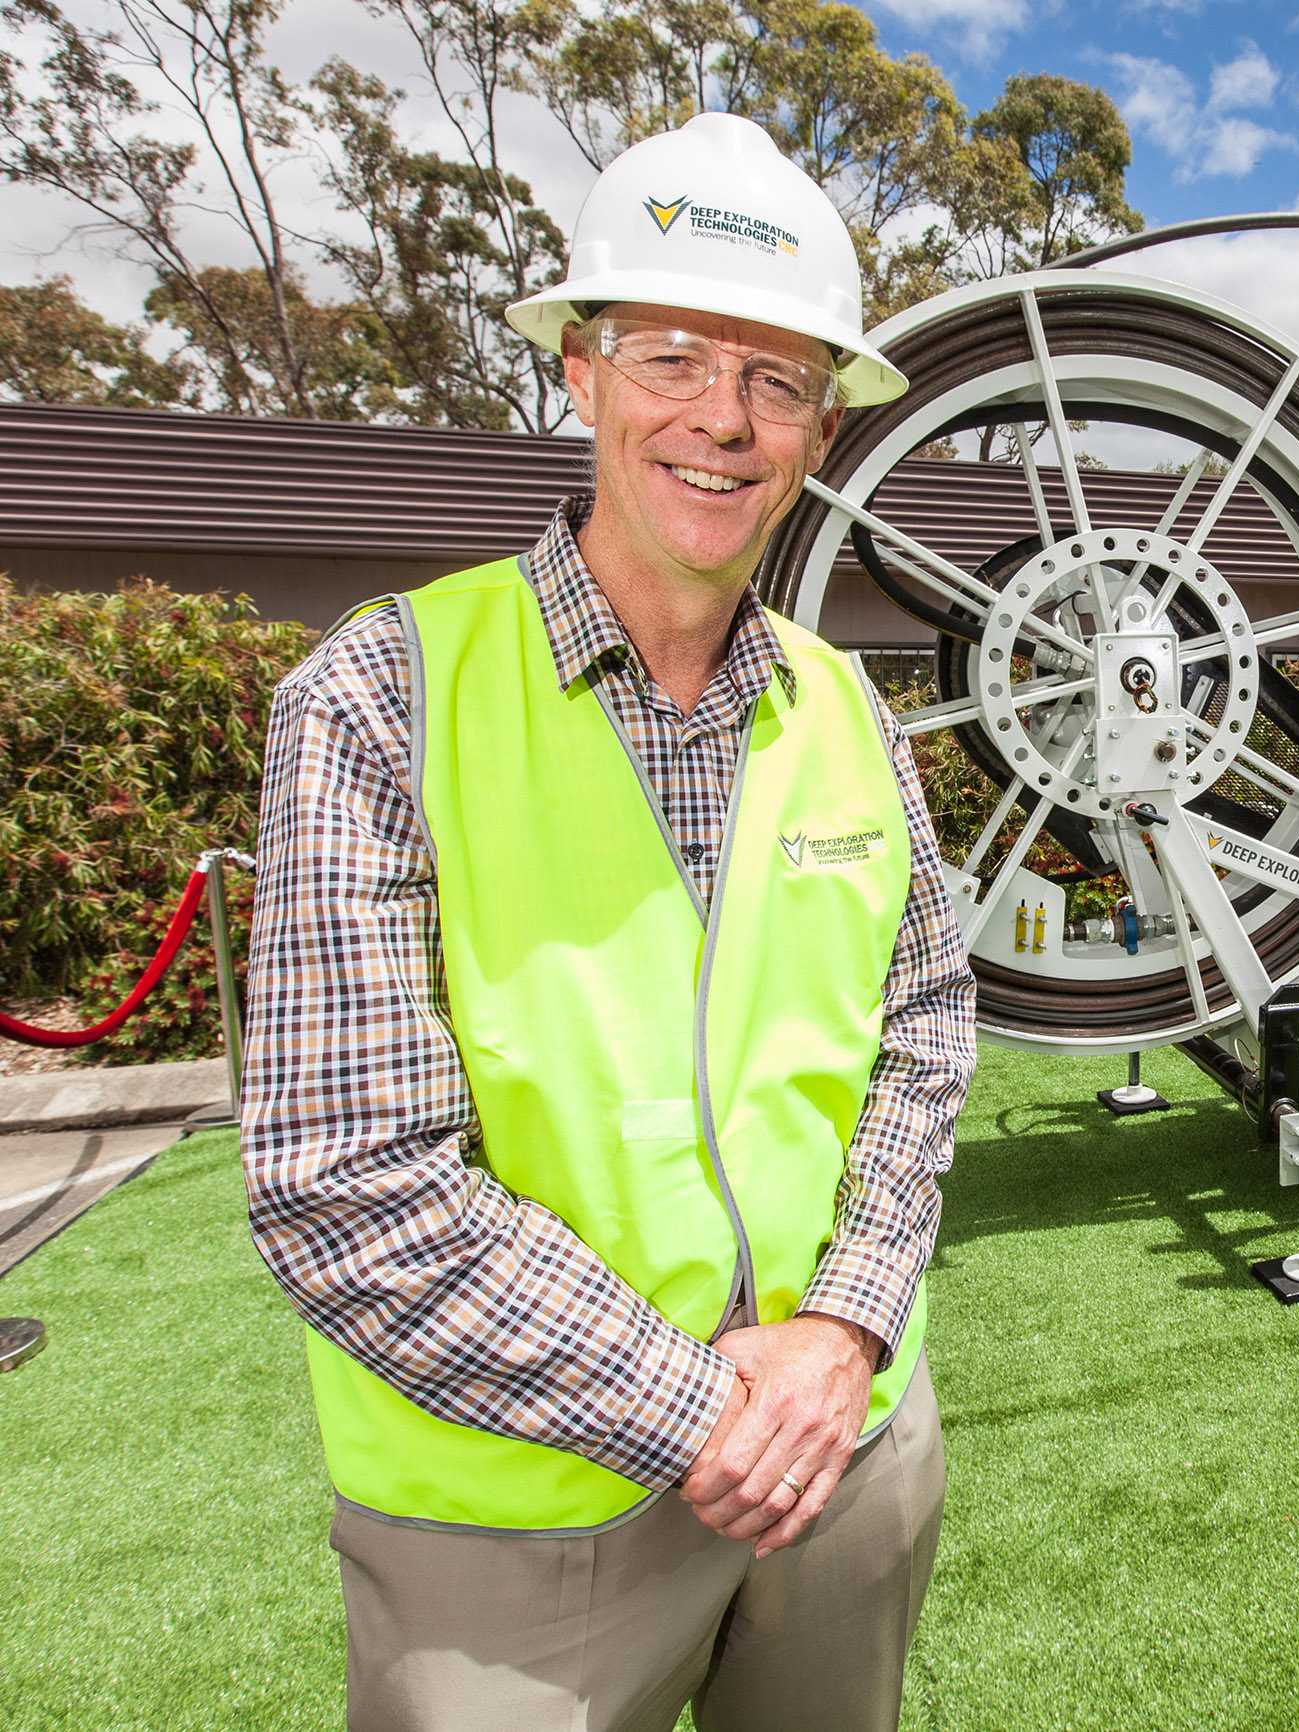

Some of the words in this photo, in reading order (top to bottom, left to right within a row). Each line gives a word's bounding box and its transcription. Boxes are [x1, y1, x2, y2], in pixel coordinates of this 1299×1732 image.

[690, 206, 722, 219] DEEP
[724, 211, 799, 247] EXPLORATION
[690, 217, 777, 247] TECHNOLOGIES
[691, 229, 737, 244] Uncovering
[754, 241, 777, 256] future
[808, 839, 827, 849] DEEP
[828, 829, 884, 847] EXPLORATION
[812, 843, 868, 857] TECHNOLOGIES
[1222, 841, 1257, 863] DEEP
